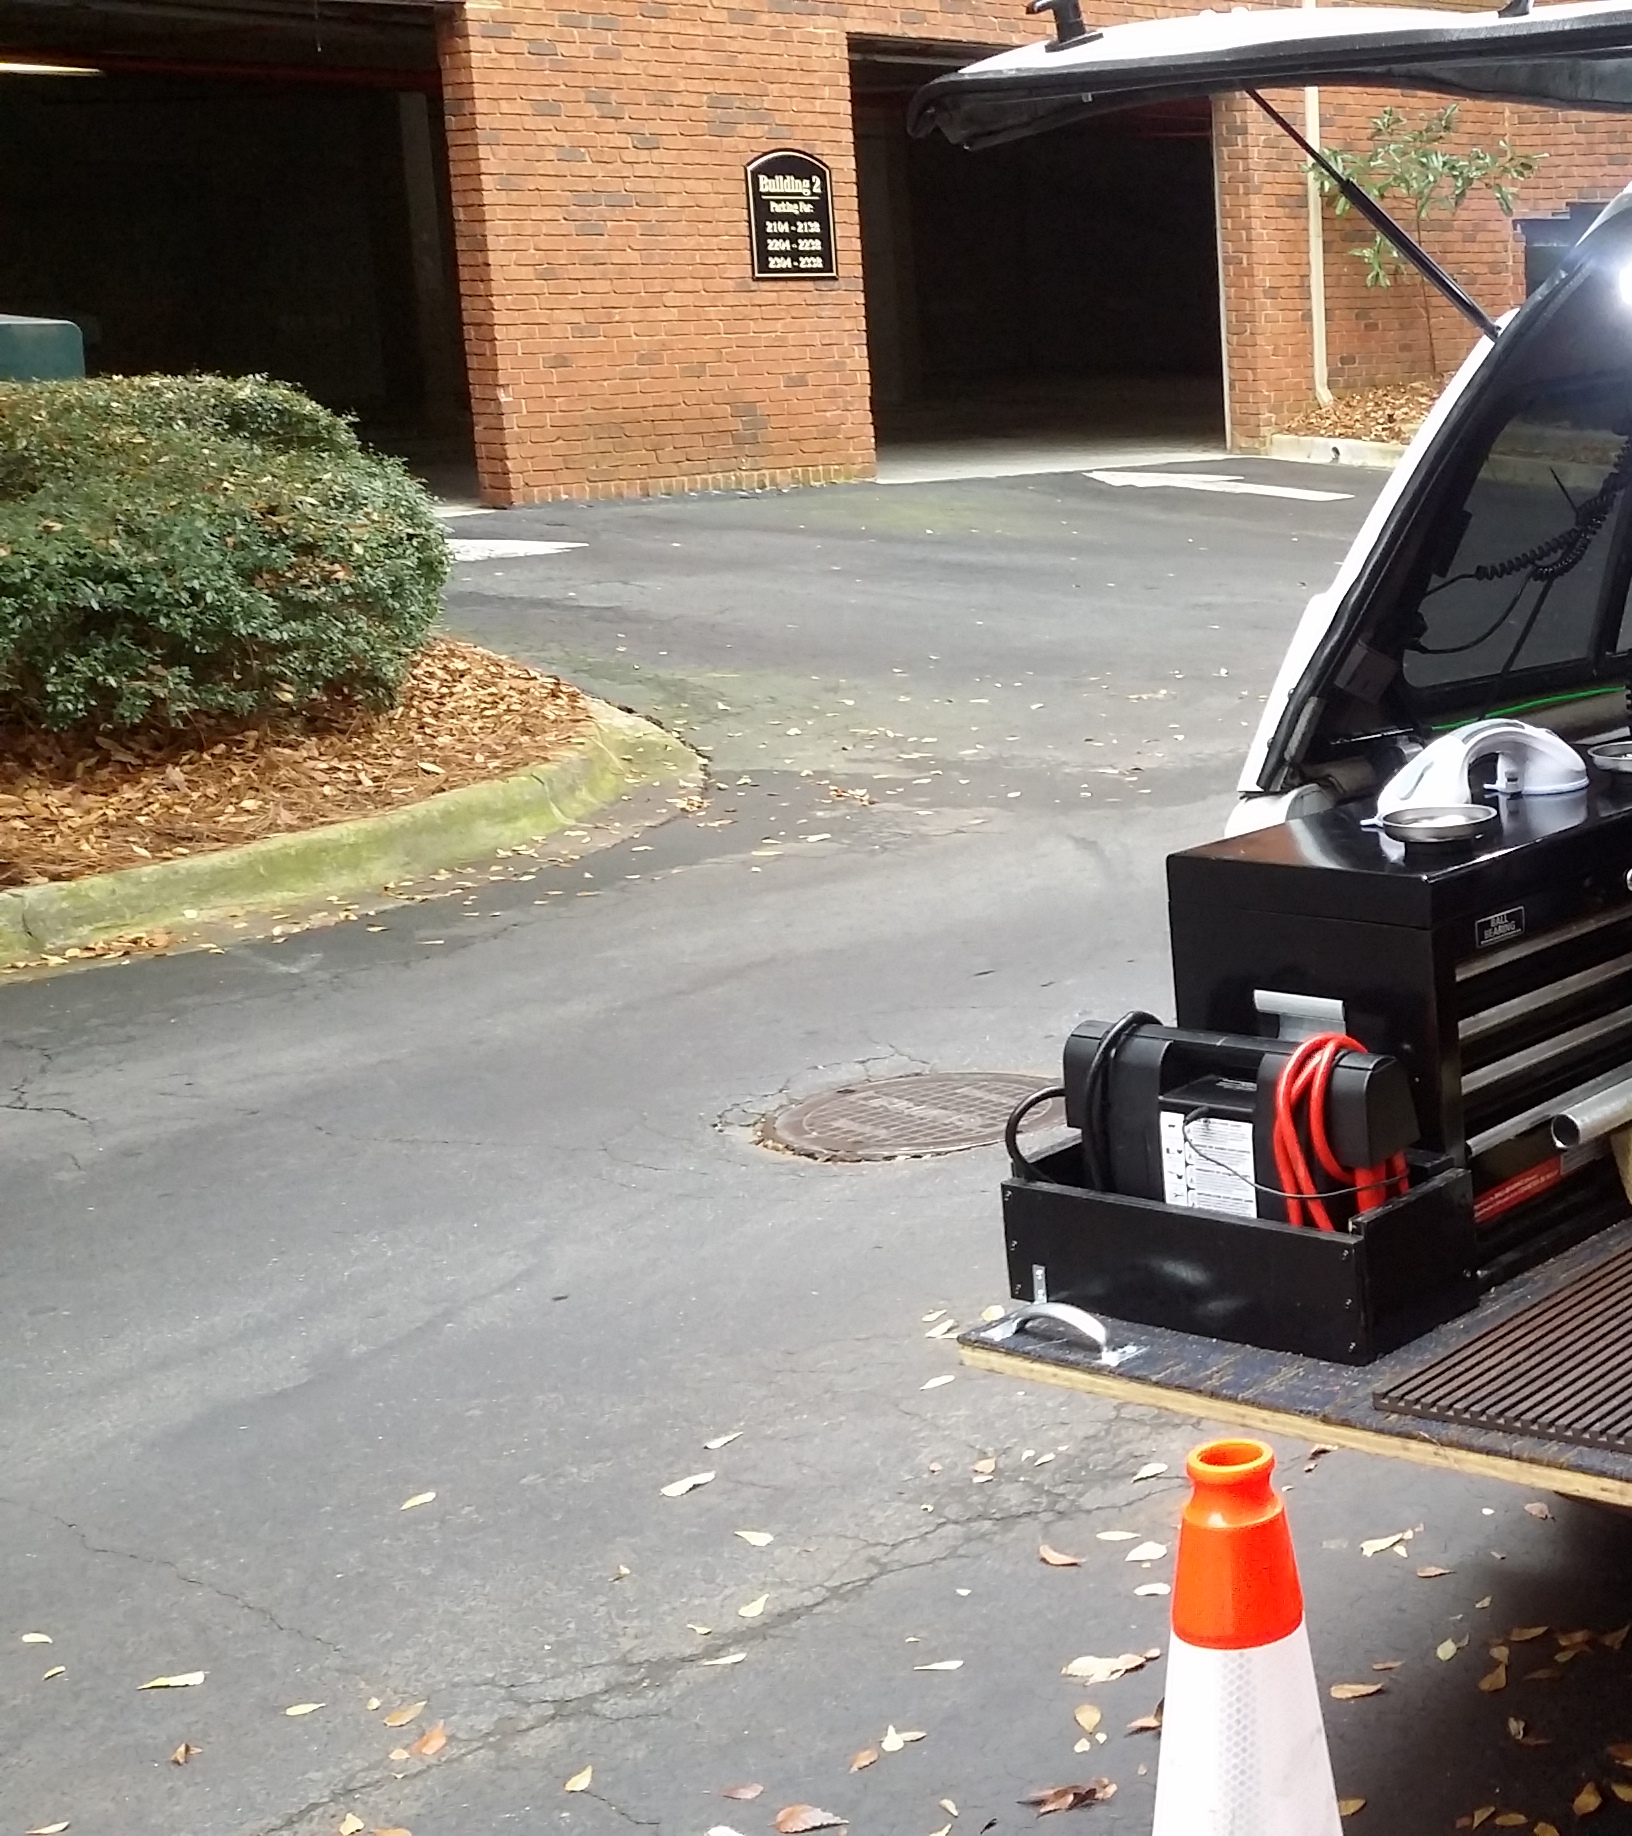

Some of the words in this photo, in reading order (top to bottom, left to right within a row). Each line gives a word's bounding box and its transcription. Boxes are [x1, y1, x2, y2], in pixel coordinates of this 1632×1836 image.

[758, 174, 811, 196] Building
[812, 175, 822, 193] 2
[770, 201, 800, 215] Parking
[765, 221, 790, 233] 2104
[767, 238, 791, 251] 2204
[1490, 914, 1509, 927] BALL
[1483, 920, 1516, 940] BEARING
